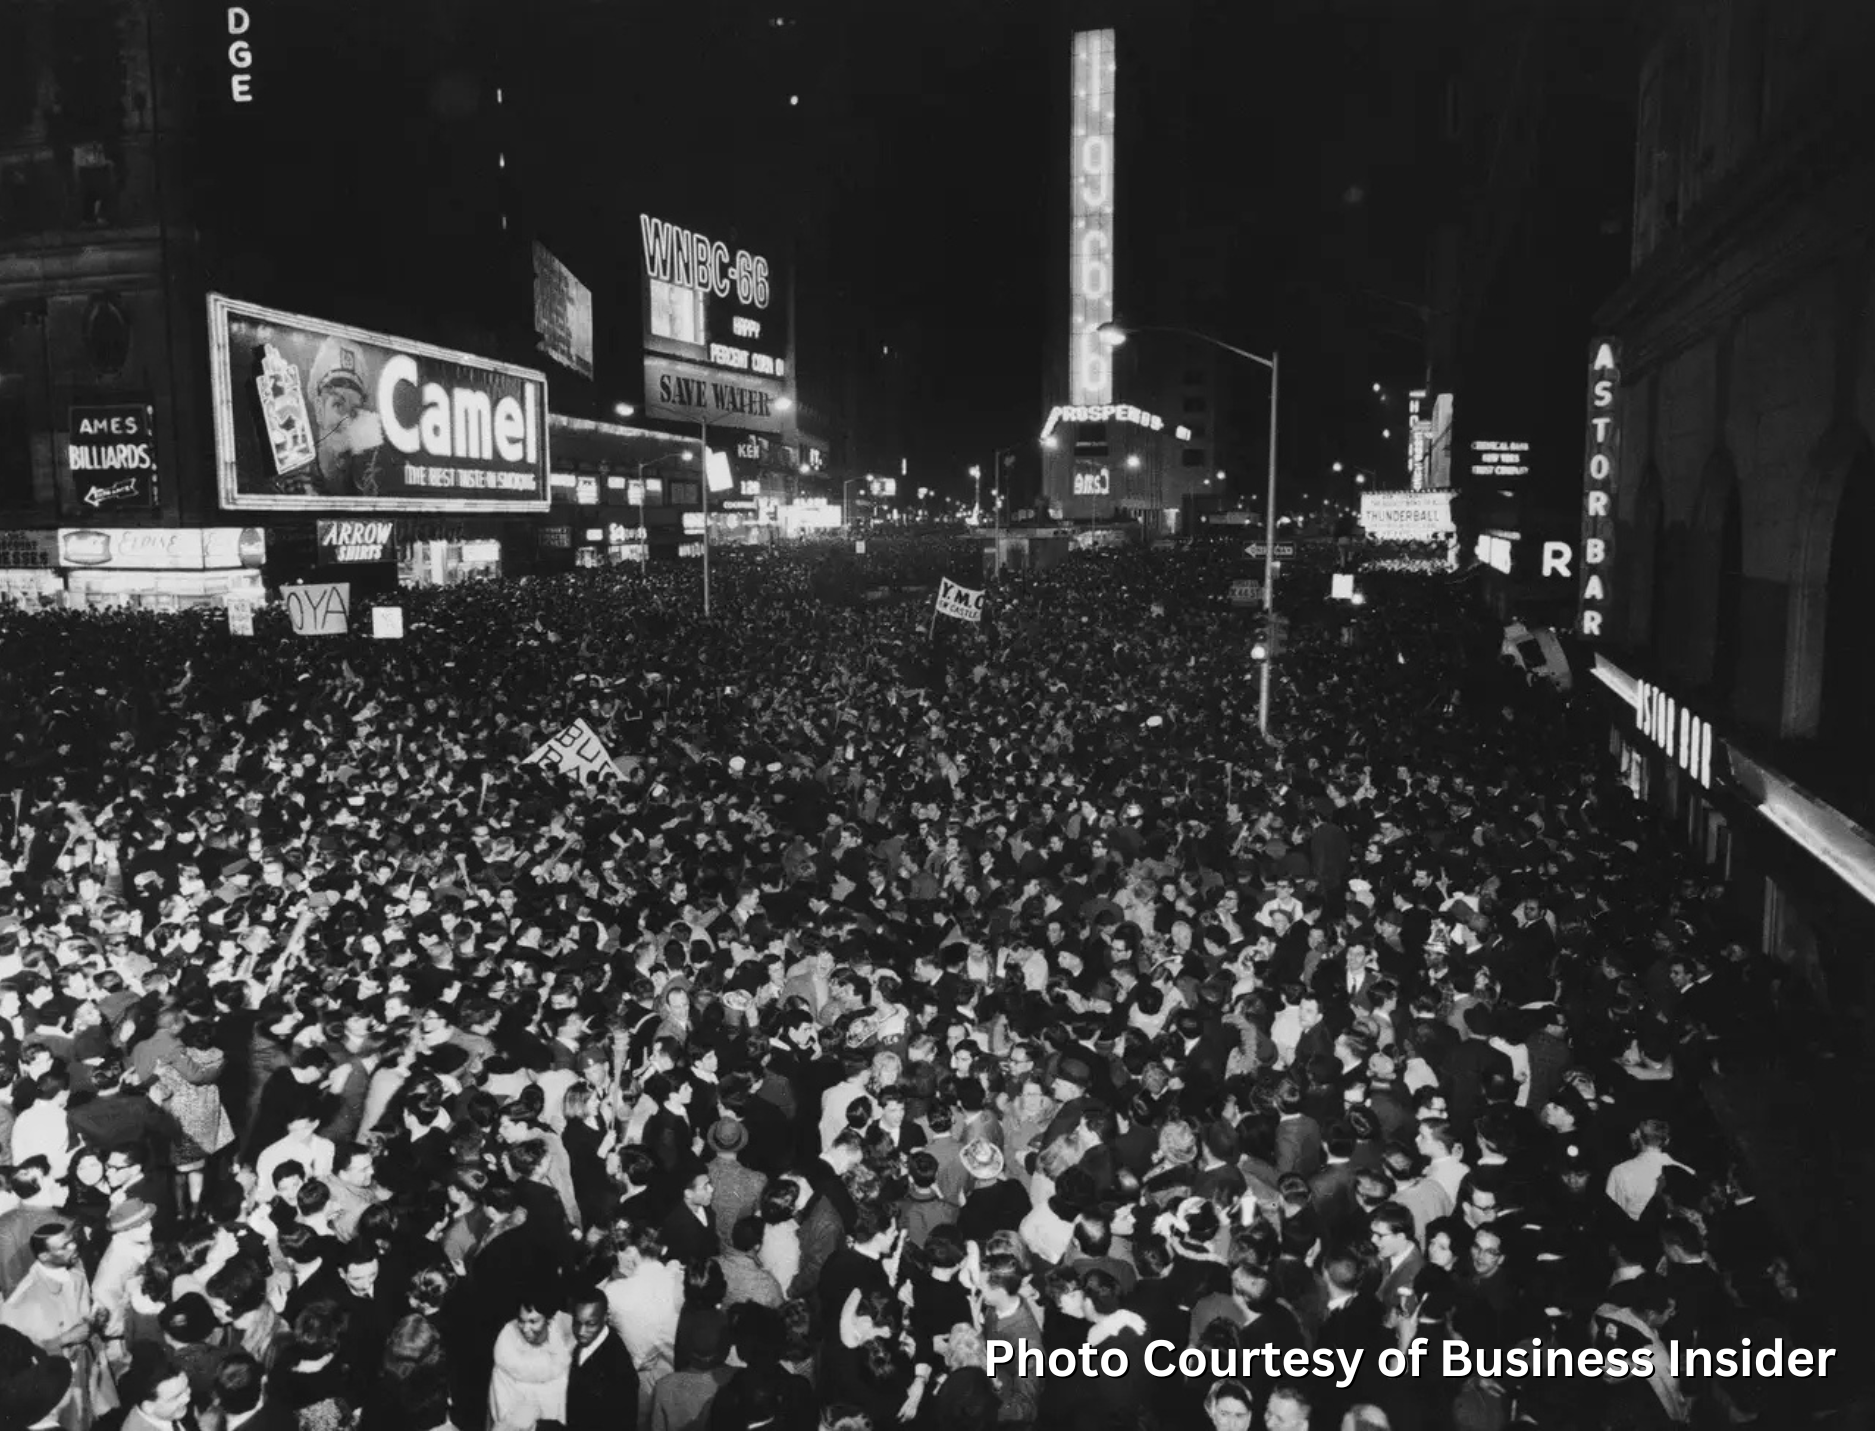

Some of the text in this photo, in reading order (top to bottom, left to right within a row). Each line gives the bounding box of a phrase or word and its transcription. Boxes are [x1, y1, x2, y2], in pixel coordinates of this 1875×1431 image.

[640, 213, 770, 310] WNBC-66
[659, 374, 771, 417] SAVE WATER
[377, 354, 537, 464] Camel
[79, 417, 138, 434] AMES
[68, 444, 151, 470] BILLIARDS
[428, 466, 455, 487] BEST
[1366, 510, 1440, 522] THUNDERBALL
[321, 522, 393, 546] ARROW
[336, 545, 383, 561] SHIRTS
[1542, 541, 1572, 577] R
[1583, 538, 1605, 636] BAR
